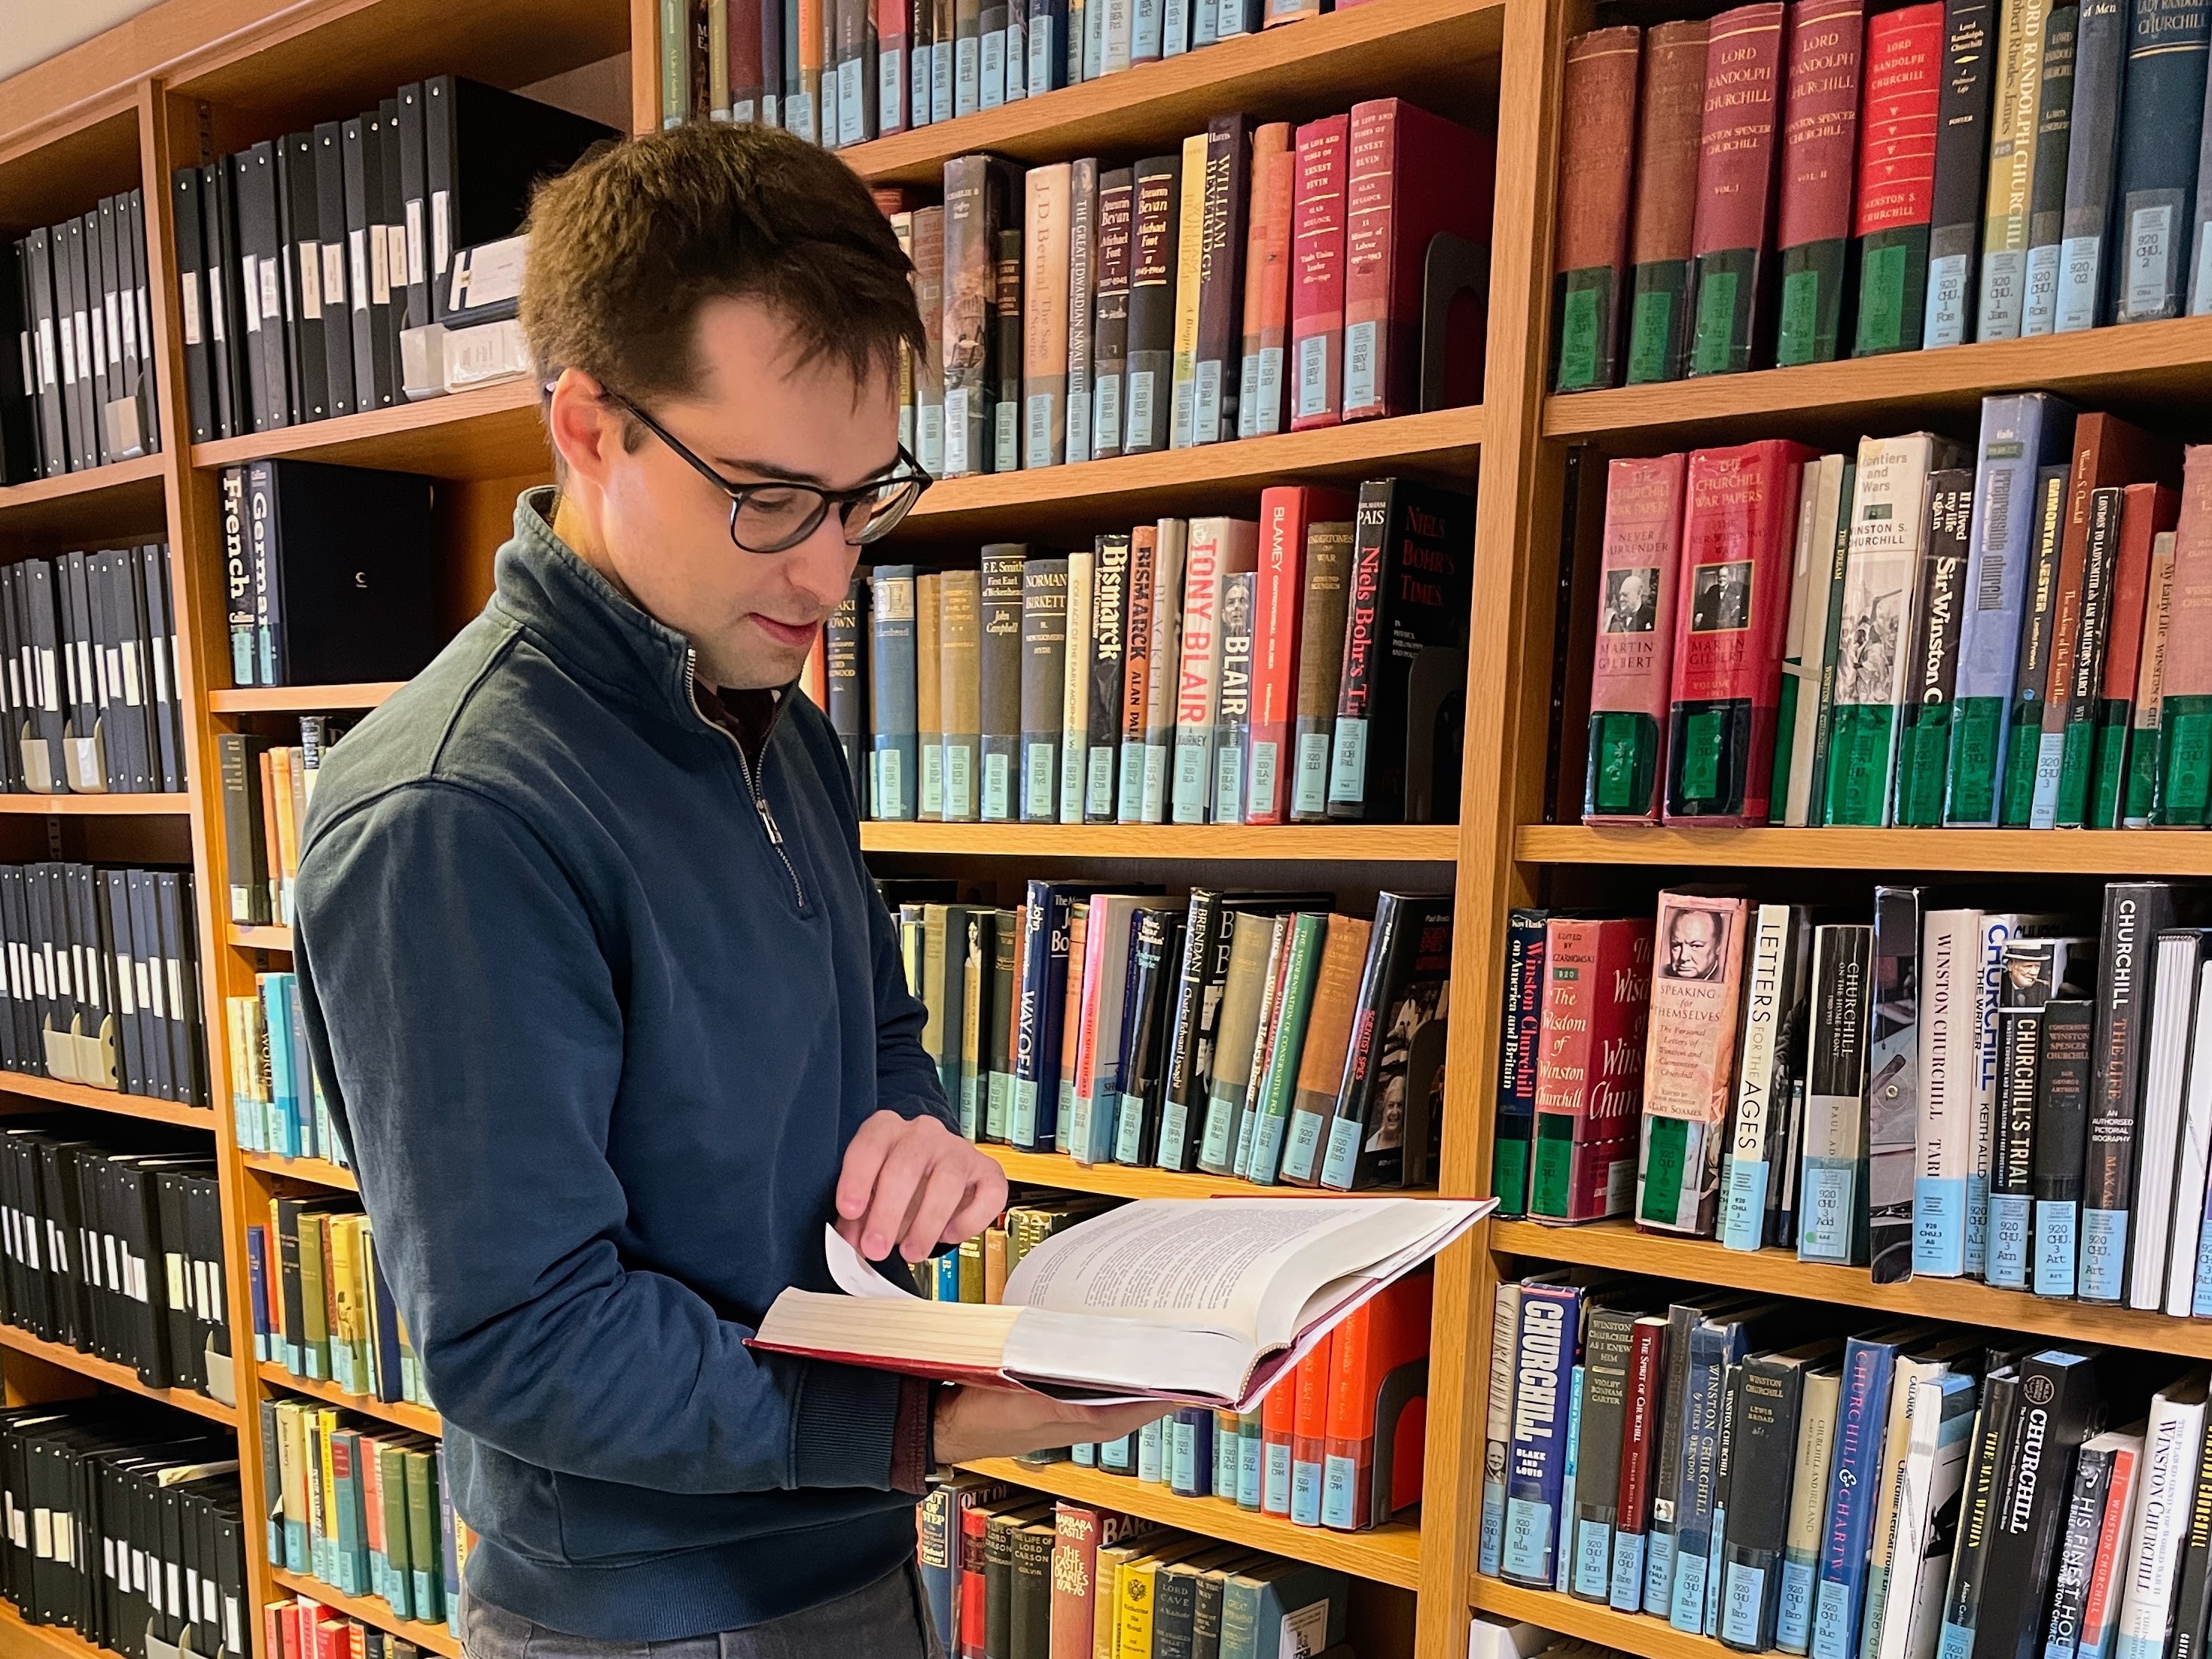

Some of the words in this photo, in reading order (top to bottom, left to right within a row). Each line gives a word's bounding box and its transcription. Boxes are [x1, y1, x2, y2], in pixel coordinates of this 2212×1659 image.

[1959, 21, 1976, 31] Lord
[2138, 13, 2206, 35] CHURCHILL
[1802, 33, 1839, 53] LORD
[1887, 40, 1911, 53] LORD
[1721, 47, 1756, 64] LORD
[1790, 53, 1854, 76] RANDOLPH
[1874, 54, 1925, 73] RANDOLPH
[1708, 67, 1771, 90] RANDOLPH
[1872, 71, 1924, 90] CHURCHILL
[1705, 90, 1771, 112] CHURCHILL
[2016, 41, 2039, 145] RANDOLPH
[1354, 141, 1384, 154] ERNEST
[1305, 163, 1332, 176] ERNEST
[1077, 200, 1086, 224] THE
[1138, 200, 1167, 214] Bevan
[1214, 155, 1230, 249] WILLIAM
[1101, 212, 1129, 226] Bevan
[1137, 221, 1166, 235] Michael
[1201, 159, 1217, 284] BEVERIDGE
[1076, 225, 1086, 262] GREAT
[1141, 236, 1158, 247] Foot
[1036, 229, 1049, 291] Bernal
[1074, 264, 1086, 326] EDWARDIAN
[1074, 330, 1083, 366] NAVAL
[1696, 473, 1763, 492] CHURCHILL
[1867, 467, 1888, 479] and
[1863, 482, 1890, 493] Wars
[1696, 496, 1719, 508] WAR
[1722, 491, 1763, 503] PAPERS
[1357, 510, 1384, 525] PAIS
[2041, 479, 2061, 557] IMMORTAL
[223, 476, 250, 599] French
[1272, 507, 1284, 572] BLAMEY
[1619, 531, 1654, 540] NEVER
[999, 561, 1024, 572] Smith
[1358, 546, 1381, 601] Niels
[1935, 556, 1956, 590] Sir
[1026, 574, 1067, 587] NORMAN
[1187, 539, 1217, 620] TONY
[2035, 560, 2052, 613] JESTER
[1025, 595, 1066, 609] BIRKETT
[1098, 544, 1128, 661] Bismarck
[1130, 546, 1151, 661] BISMARCK
[1349, 607, 1374, 677] Bohr's
[1601, 643, 1653, 653] MARTIN
[1926, 592, 1953, 686] Winston
[1599, 657, 1652, 669] GILBERT
[1179, 632, 1211, 723] BLAIR
[1222, 636, 1250, 715] BLAIR
[1131, 672, 1141, 705] ALAN
[1176, 735, 1206, 746] JOURNEY
[2040, 758, 2059, 767] 920
[1033, 903, 1044, 931] John
[1191, 908, 1208, 973] BRENDAN
[1512, 940, 1521, 956] on
[2113, 899, 2136, 1010] CHURCHILL
[1523, 942, 1543, 1011] Winston
[1752, 925, 1780, 1022] LETTERS
[1934, 933, 1951, 1015] WINSTON
[1509, 959, 1523, 1011] America
[1660, 985, 1716, 998] SPEAKING
[1550, 986, 1577, 1006] The
[1680, 998, 1693, 1008] for
[1019, 991, 1034, 1028] WAY
[1653, 1006, 1720, 1021] THEMSELVES
[1842, 962, 1859, 1054] CHURCHILL
[1360, 1010, 1375, 1053] SCIENTIST
[1507, 1015, 1518, 1039] and
[1542, 1011, 1586, 1032] Wisdom
[1674, 1027, 1706, 1036] Personal
[1974, 1000, 1982, 1050] WRITER
[1551, 1036, 1571, 1056] of
[1664, 1037, 1687, 1046] Letters
[1752, 1027, 1764, 1050] FOR
[2110, 1019, 2127, 1054] THE
[1504, 1040, 1517, 1088] Britain
[1517, 1015, 1538, 1098] Churchill
[1749, 1055, 1761, 1078] THE
[2047, 1052, 2089, 1060] CHURCHILL
[1539, 1060, 1584, 1081] Winston
[1929, 1021, 1947, 1120] CHURCHILL
[2012, 1019, 2037, 1131] CHURCHILL'S
[1536, 1085, 1582, 1107] Churchill
[1738, 1081, 1762, 1149] AGES
[1979, 1103, 1989, 1141] KEITH
[2092, 1134, 2131, 1143] BIOGRAPHY
[2095, 1126, 2129, 1134] PICTORIAL
[2009, 1137, 2030, 1187] TRIAL
[1819, 1190, 1836, 1199] 920
[2000, 1222, 2018, 1231] 920
[2048, 1225, 2067, 1234] 920
[2089, 1235, 2107, 1244] 920
[1589, 1330, 1634, 1342] CHURCHILL
[1593, 1320, 1632, 1332] WINSTON
[1601, 1353, 1618, 1362] HIM
[1607, 1344, 1632, 1352] KNEW
[1515, 1301, 1564, 1442] CHURCHILL
[1749, 1374, 1782, 1387] WINSTON
[1591, 1387, 1622, 1396] BONHAM
[1595, 1378, 1621, 1387] VIOLET
[1746, 1384, 1784, 1399] CHURCHILL
[1592, 1395, 1621, 1405] CARTER
[1705, 1363, 1720, 1430] WINSTON
[1906, 1375, 1917, 1419] CALLAHAN
[1725, 1390, 1734, 1427] WINSTON
[1747, 1414, 1774, 1423] BROAD
[1750, 1405, 1772, 1415] LEWIS
[1845, 1351, 1867, 1466] CHURCHILL
[1634, 1396, 1646, 1443] CHURCHILL
[1516, 1448, 1546, 1460] BLAKE
[1719, 1429, 1732, 1477] CHURCHILL
[1814, 1420, 1825, 1468] CHURCHILL
[2150, 1420, 2177, 1496] WINSTON
[1516, 1466, 1543, 1478] LOUIS
[1696, 1436, 1714, 1516] CHURCHILL
[2010, 1409, 2047, 1534] CHURCHILL
[922, 1513, 944, 1525] STEP
[1806, 1488, 1819, 1533] IRELAND
[2076, 1497, 2095, 1528] HIS
[1056, 1514, 1093, 1532] BARBARA
[1058, 1525, 1085, 1540] CASTLE
[1969, 1499, 1986, 1547] WITHIN
[2104, 1499, 2120, 1550] WINSTON
[988, 1533, 1006, 1542] LORD
[1025, 1536, 1040, 1544] LIFE
[2136, 1500, 2165, 1594] CHURCHILL
[1015, 1551, 1049, 1563] CARSON
[1019, 1544, 1042, 1553] LORD
[1062, 1545, 1080, 1562] THE
[1056, 1556, 1085, 1574] CASTLE
[2064, 1535, 2089, 1600] FINEST
[1055, 1569, 1088, 1586] DIARIES
[1056, 1579, 1085, 1597] 1974-76
[2091, 1553, 2110, 1613] CHURCHILL
[1161, 1595, 1189, 1606] CAVE
[1162, 1584, 1188, 1596] LORD
